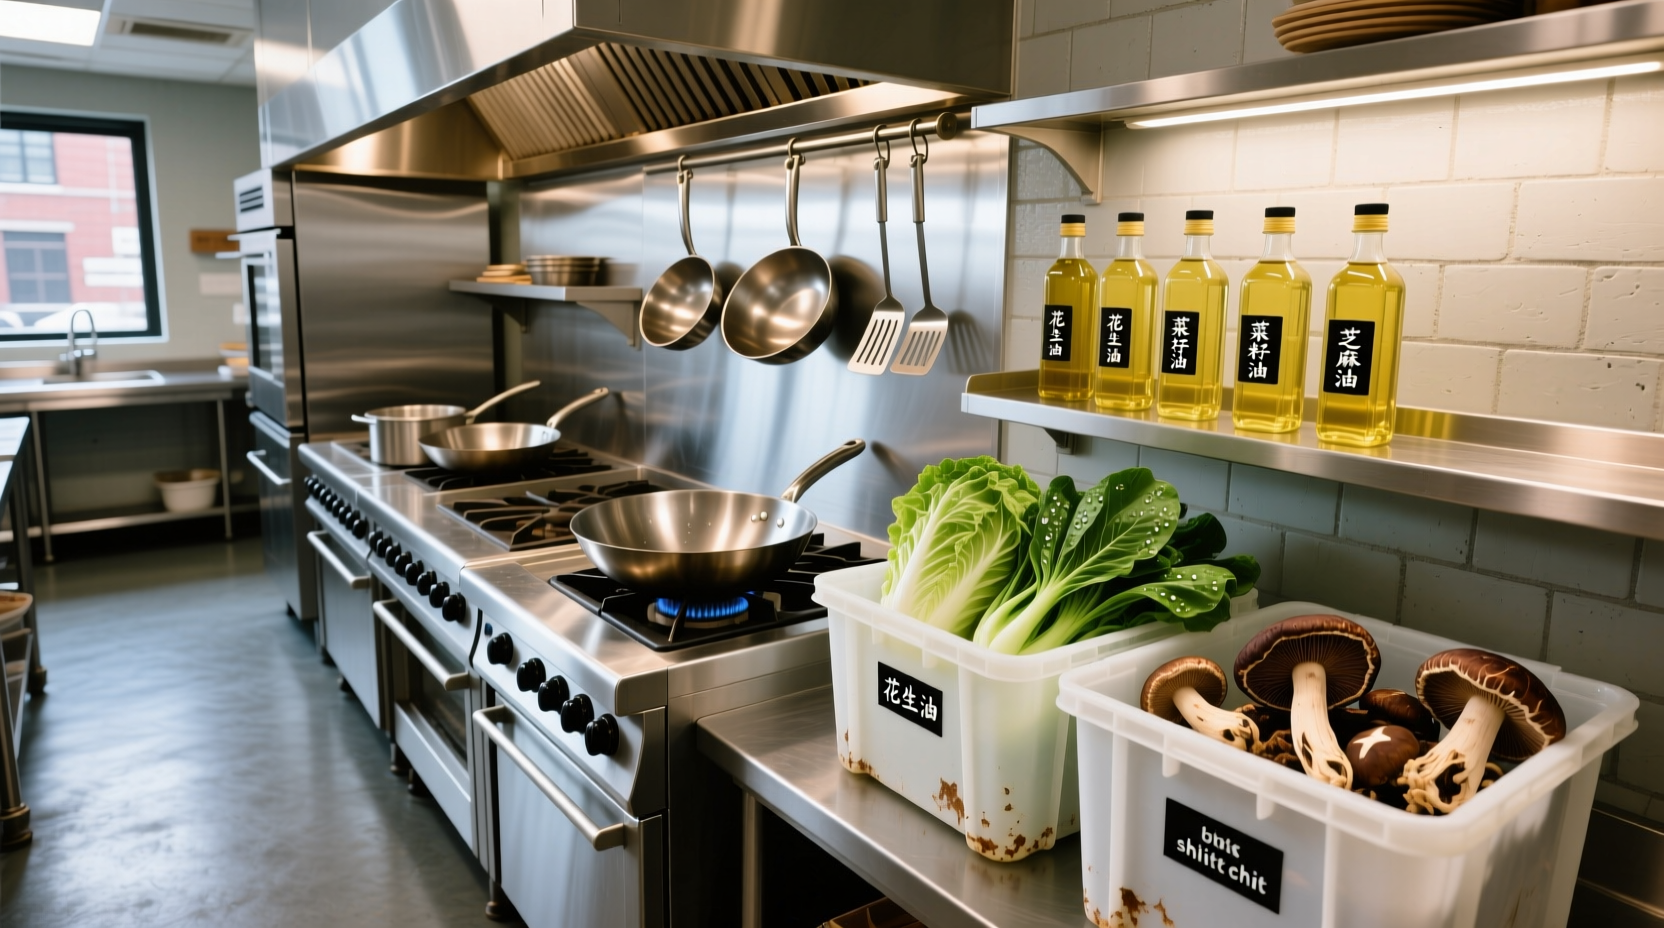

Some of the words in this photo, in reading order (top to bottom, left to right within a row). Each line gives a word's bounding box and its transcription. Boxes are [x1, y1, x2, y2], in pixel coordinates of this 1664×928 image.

[1107, 313, 1124, 363] 花生油
[1248, 320, 1271, 379] 菜籽油
[1335, 327, 1361, 389] 芝麻油
[883, 677, 938, 722] 花生油
[1228, 864, 1268, 895] chit
